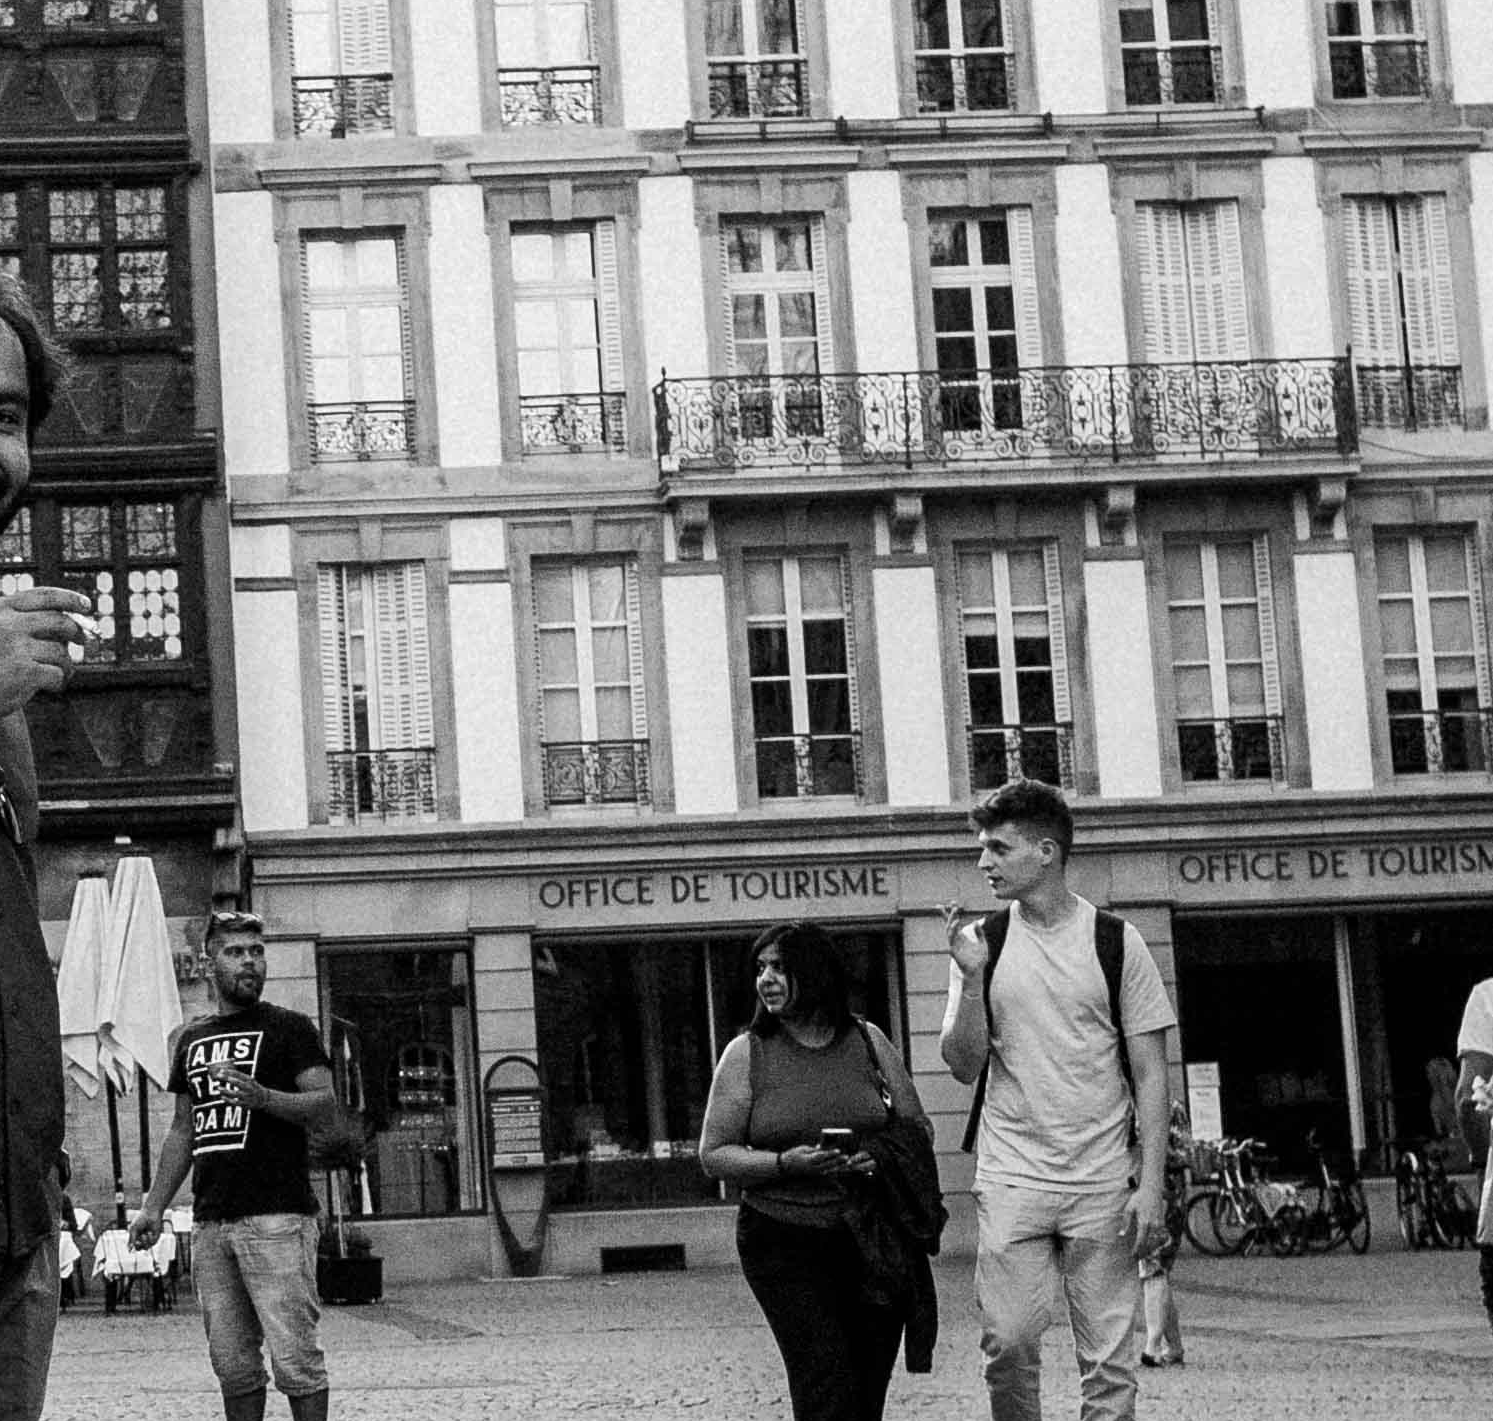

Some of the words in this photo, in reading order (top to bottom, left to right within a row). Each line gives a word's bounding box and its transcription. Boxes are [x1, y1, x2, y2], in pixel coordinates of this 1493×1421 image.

[1180, 852, 1292, 882] OFFICE
[1308, 850, 1348, 879] DE
[539, 877, 654, 908] OFFICE
[671, 875, 710, 903] DE
[723, 867, 889, 901] TOURISME
[192, 1038, 251, 1066] AMS
[195, 1106, 242, 1132] DAM
